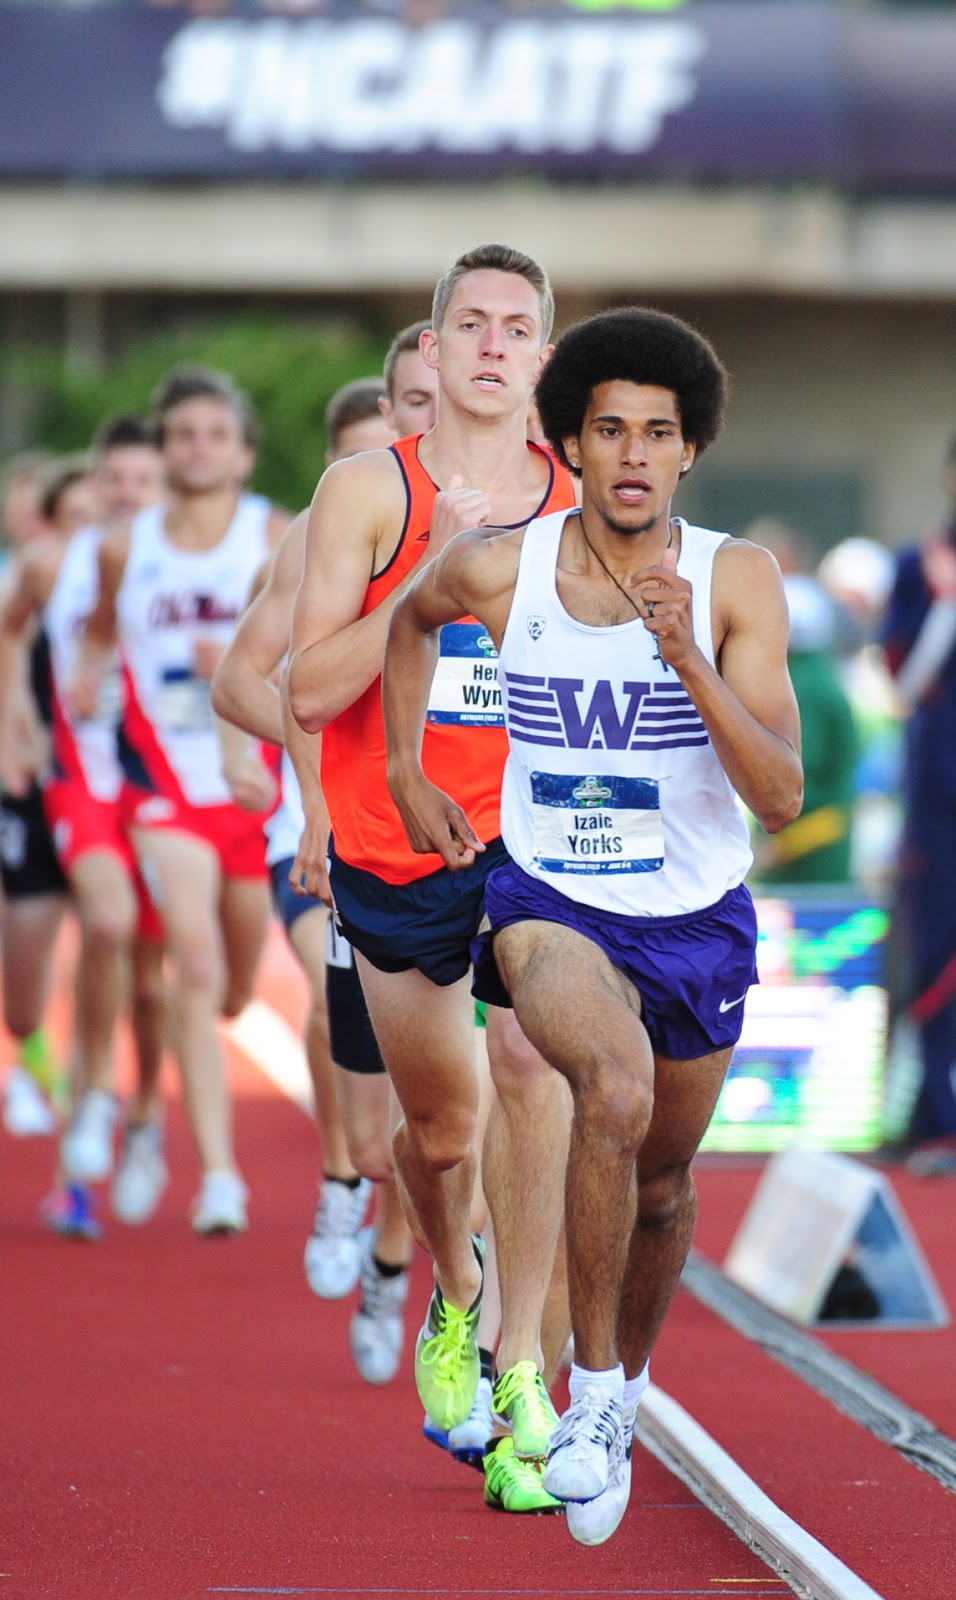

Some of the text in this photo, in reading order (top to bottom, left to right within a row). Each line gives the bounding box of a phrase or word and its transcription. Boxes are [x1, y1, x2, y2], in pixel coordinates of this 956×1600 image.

[160, 20, 702, 149] #NCAATF
[548, 677, 651, 750] W
[567, 834, 623, 855] Yorks
[574, 813, 613, 830] Izaic
